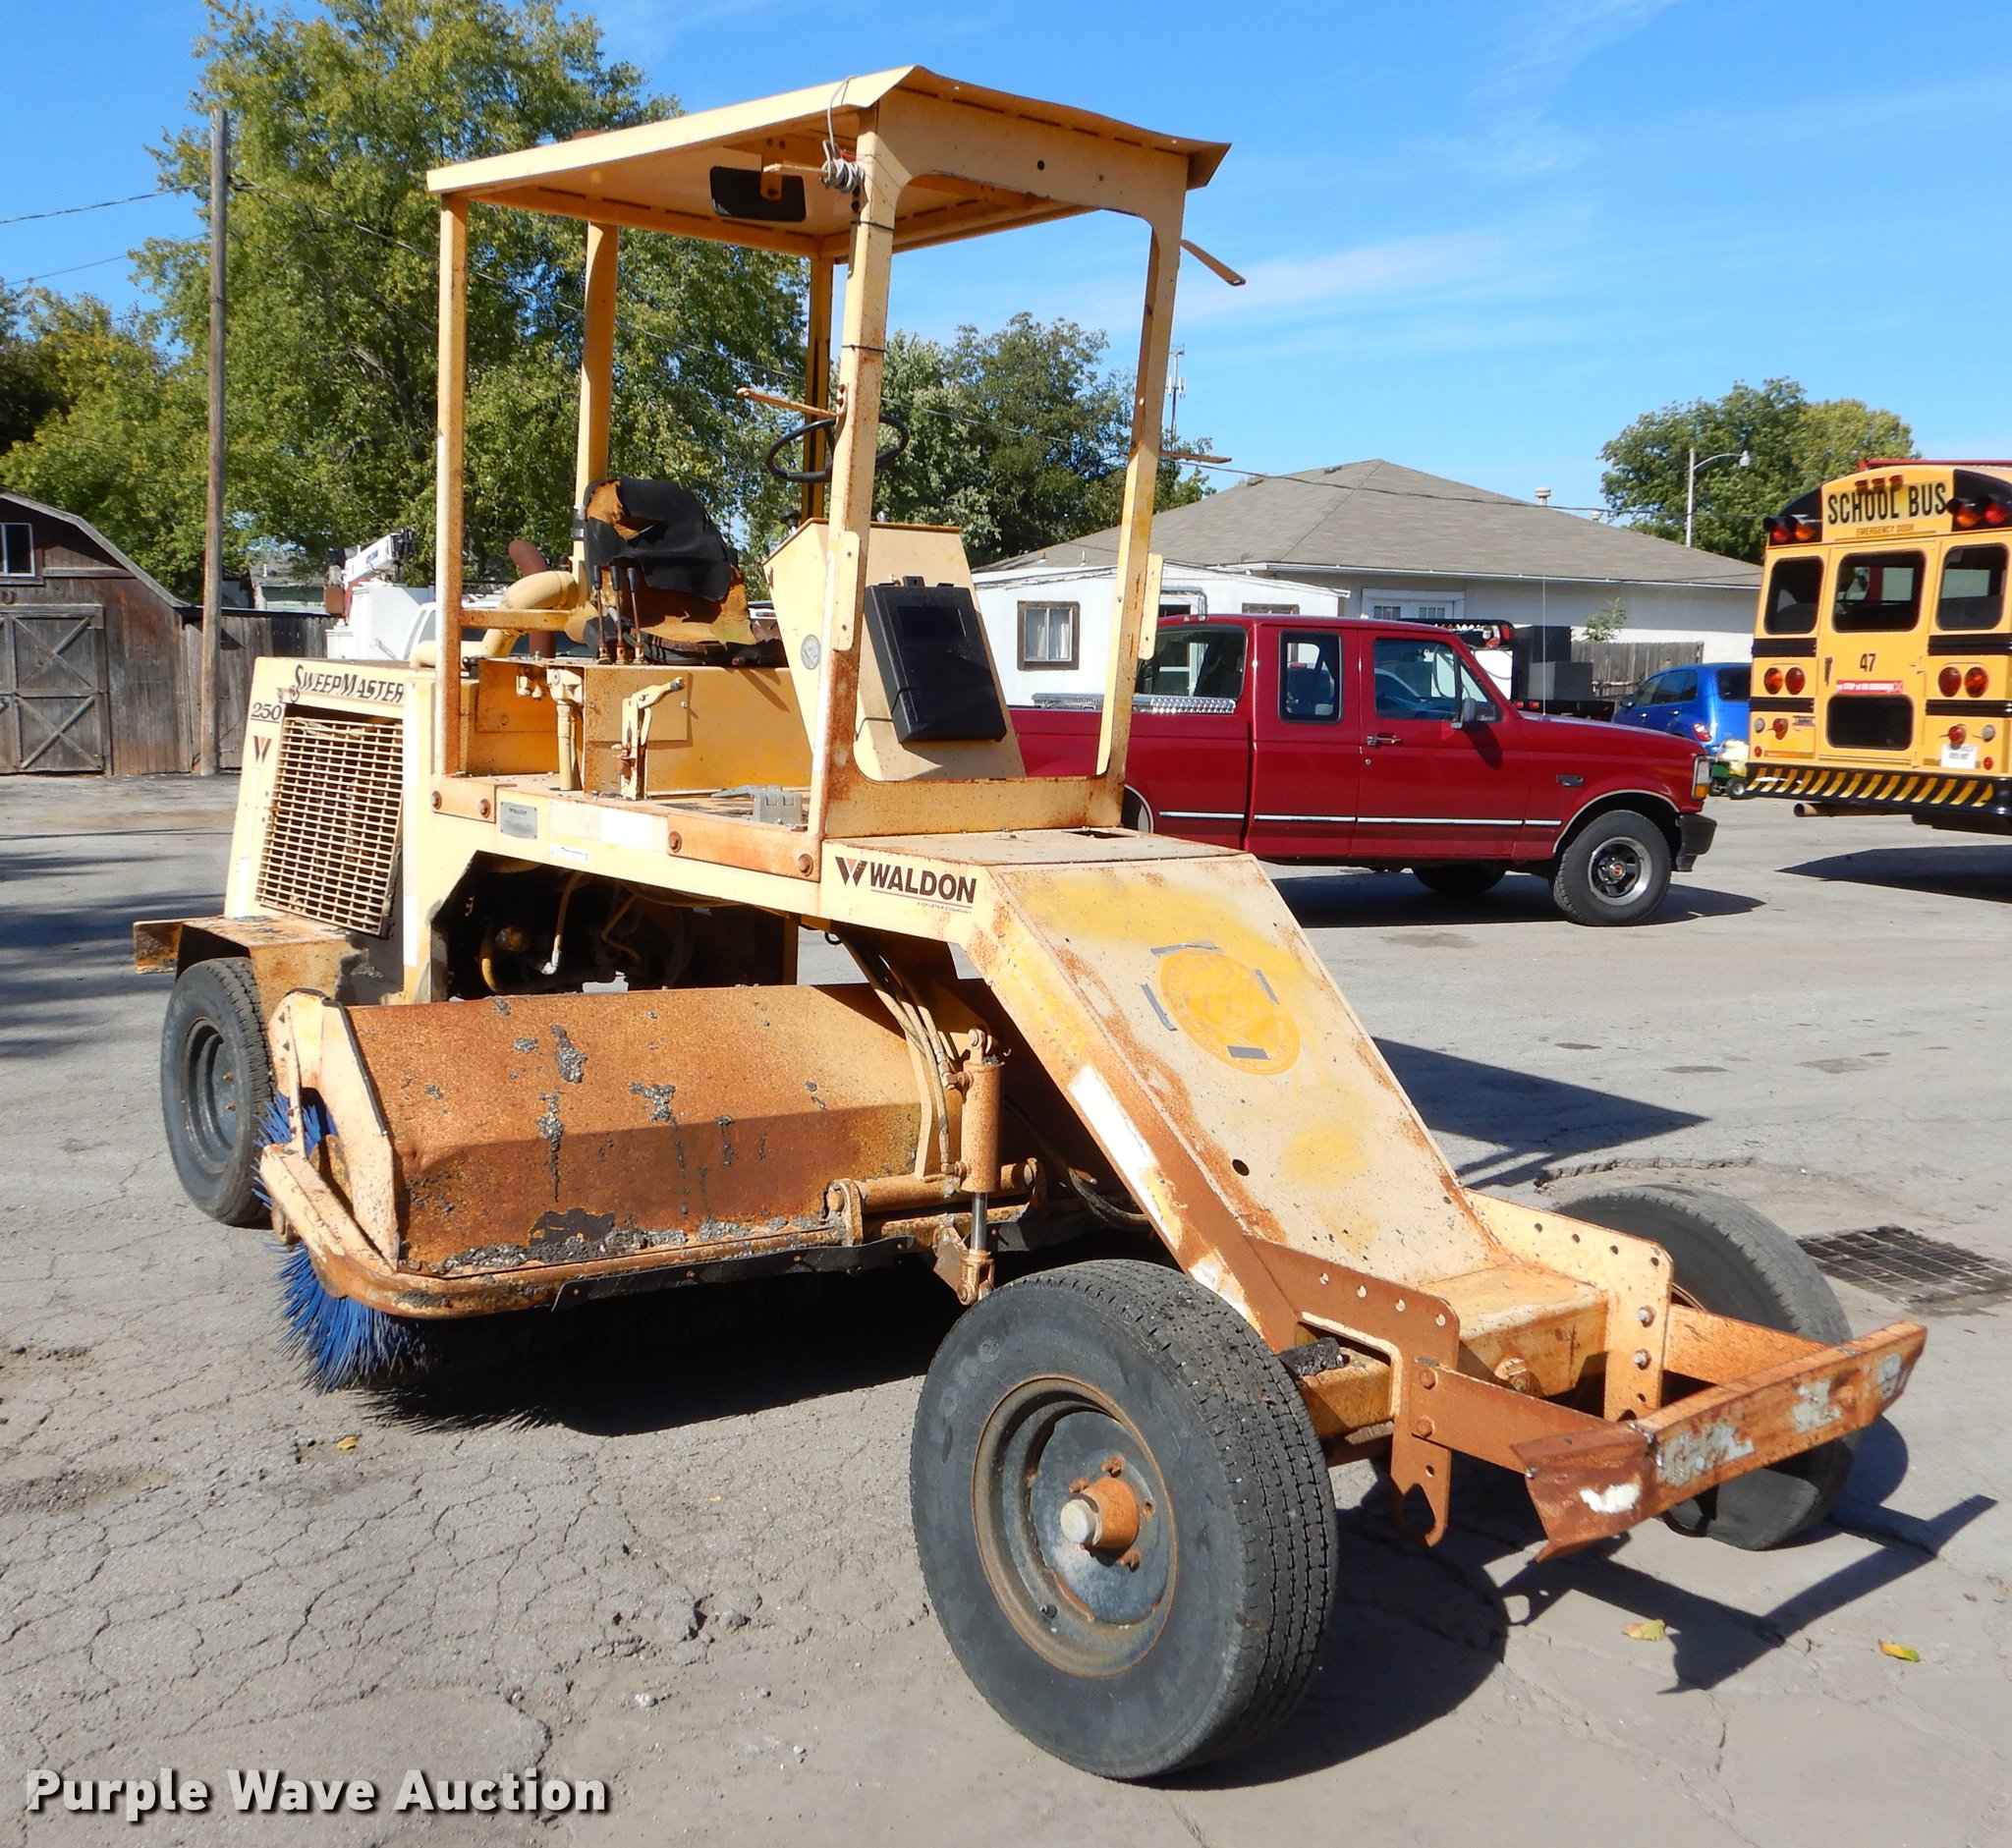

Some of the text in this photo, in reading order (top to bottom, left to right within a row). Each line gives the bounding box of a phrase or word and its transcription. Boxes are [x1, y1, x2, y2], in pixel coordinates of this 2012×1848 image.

[1828, 482, 1946, 525] SCHOOL BUS
[1856, 525, 1895, 536] EMERGENCY
[1860, 653, 1876, 672] 47
[251, 702, 283, 720] 250
[870, 862, 977, 904] WALDON
